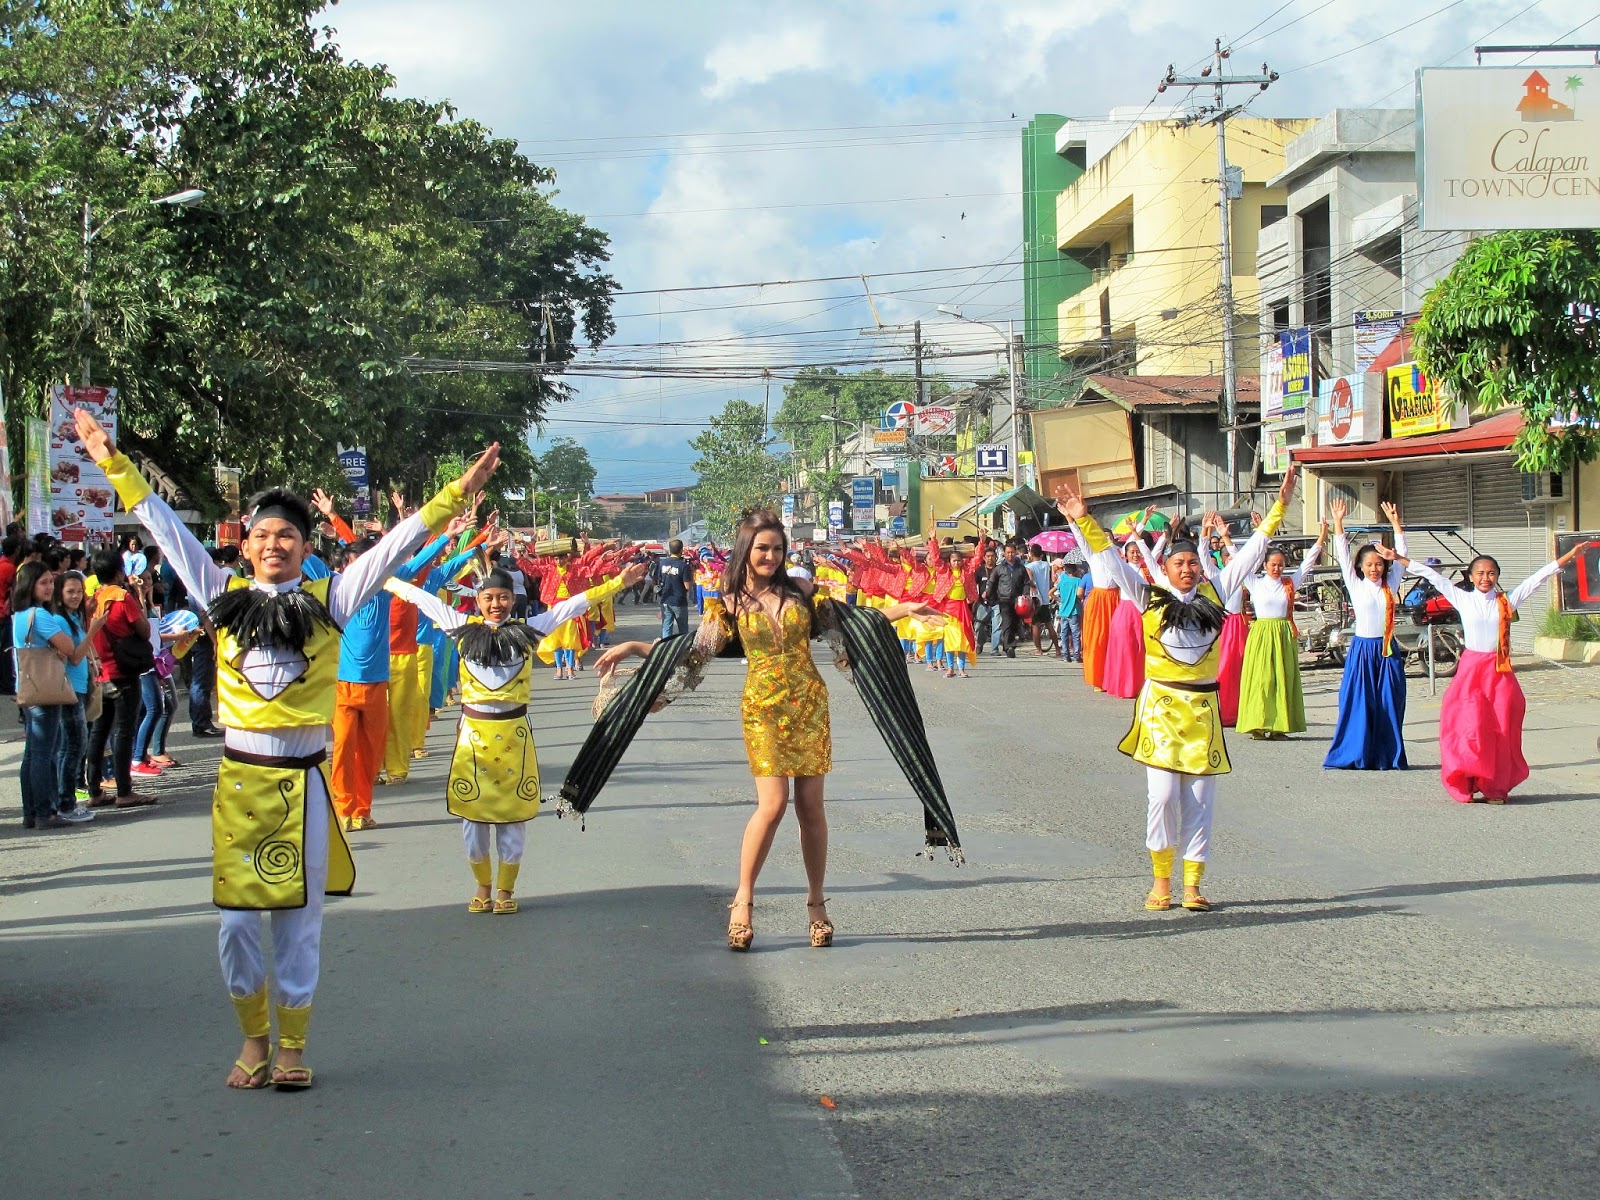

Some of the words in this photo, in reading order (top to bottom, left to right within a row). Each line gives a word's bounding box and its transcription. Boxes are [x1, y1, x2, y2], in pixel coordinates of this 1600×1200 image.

[1490, 128, 1590, 198] Calapan
[1443, 178, 1525, 198] TOWN
[1391, 376, 1433, 422] GRAFICO
[977, 444, 1007, 452] HOSPITAL
[340, 457, 366, 467] FREE
[982, 451, 1003, 466] H
